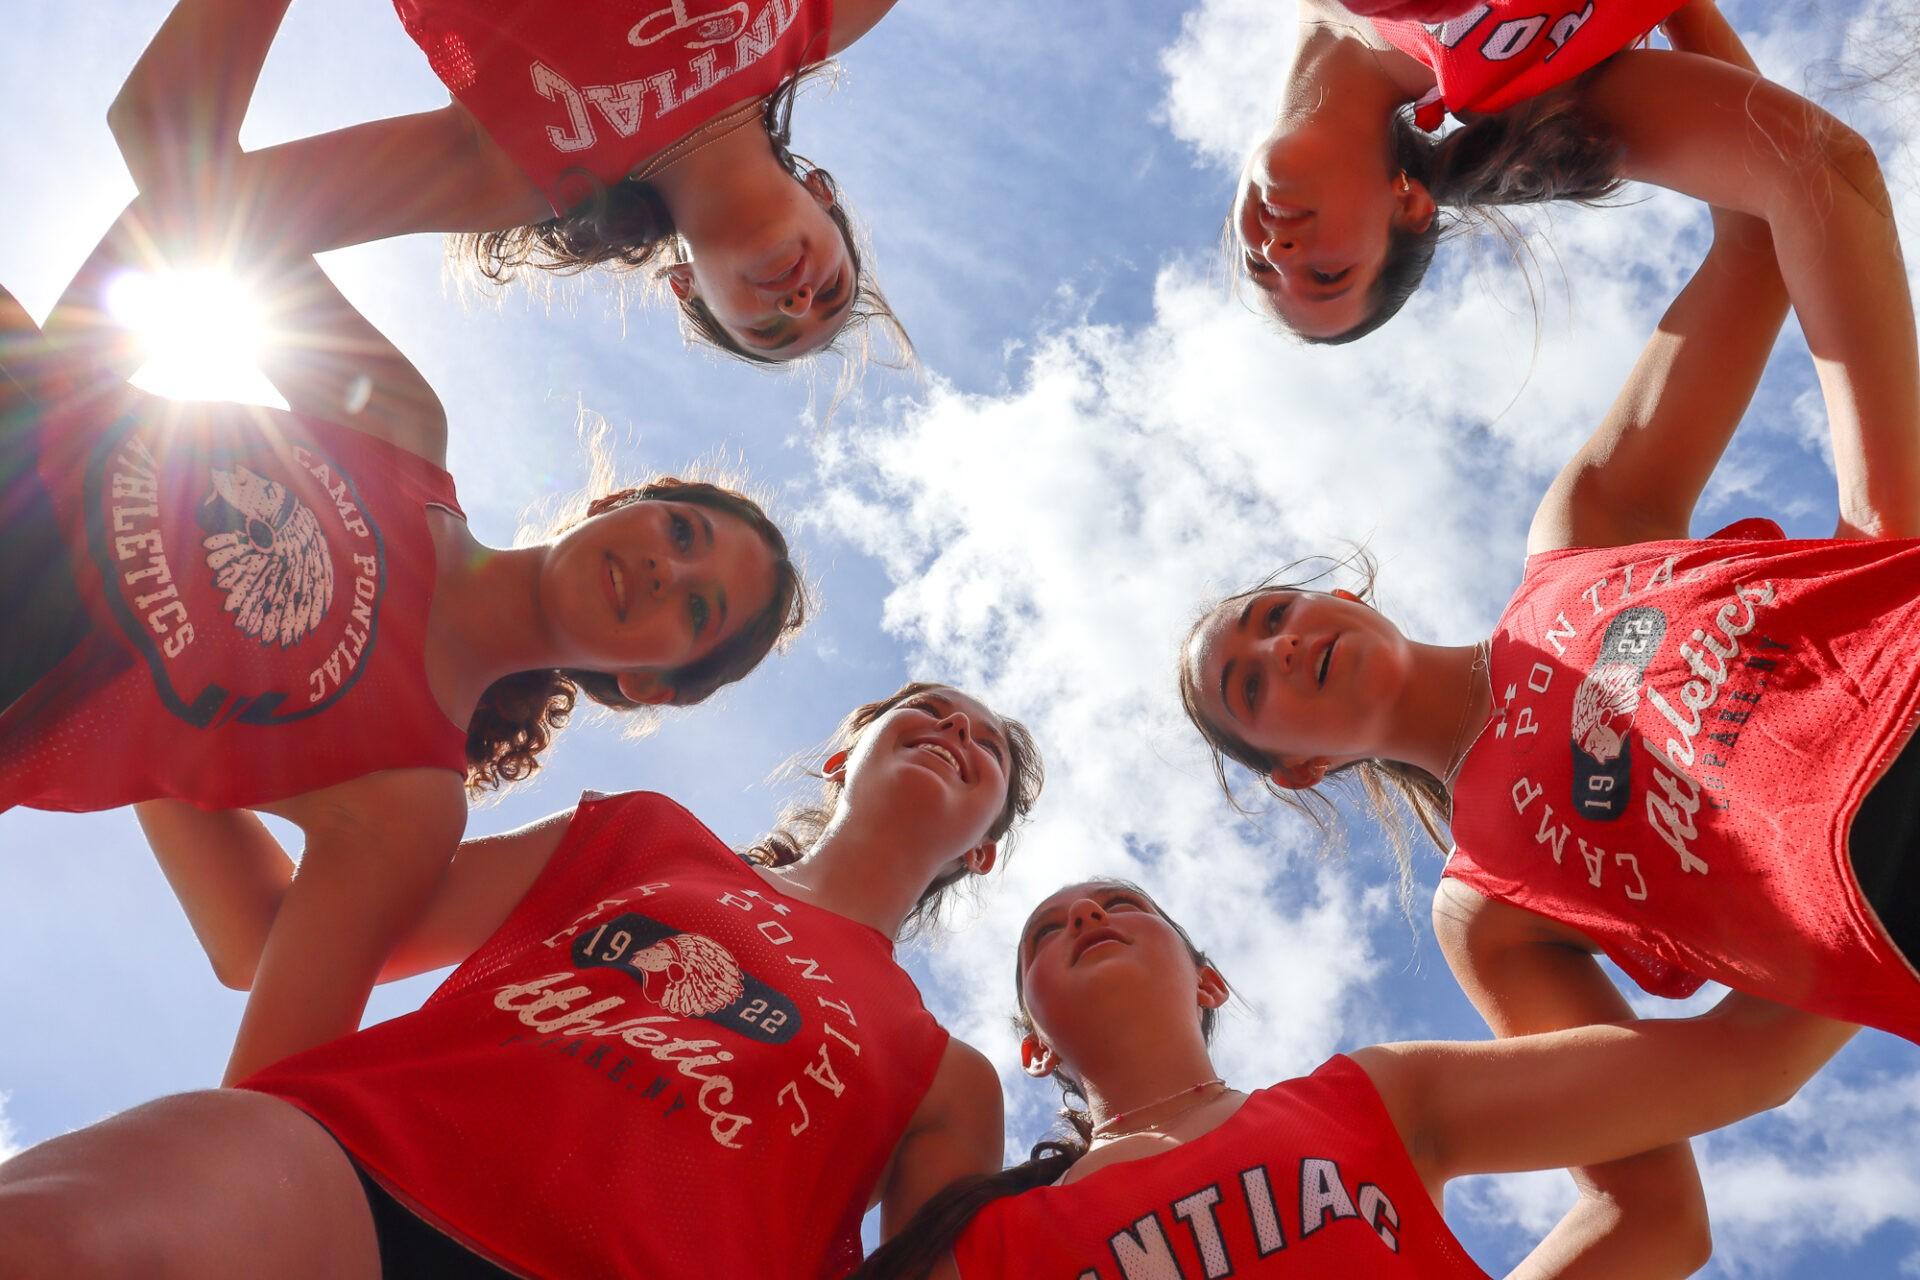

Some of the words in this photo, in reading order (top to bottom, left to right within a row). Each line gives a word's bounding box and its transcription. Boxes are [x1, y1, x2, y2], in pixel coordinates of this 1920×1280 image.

[292, 445, 370, 540] CAMP
[309, 552, 376, 703] PONTIAC
[1585, 774, 1615, 810] 19
[1618, 617, 1653, 654] 22
[1643, 581, 1776, 875] Athletics
[1512, 776, 1648, 901] CAMP
[582, 924, 634, 963] 19
[739, 998, 789, 1034] 22
[716, 890, 861, 1137] PONTIAC
[1077, 1157, 1399, 1280] NTIAC
